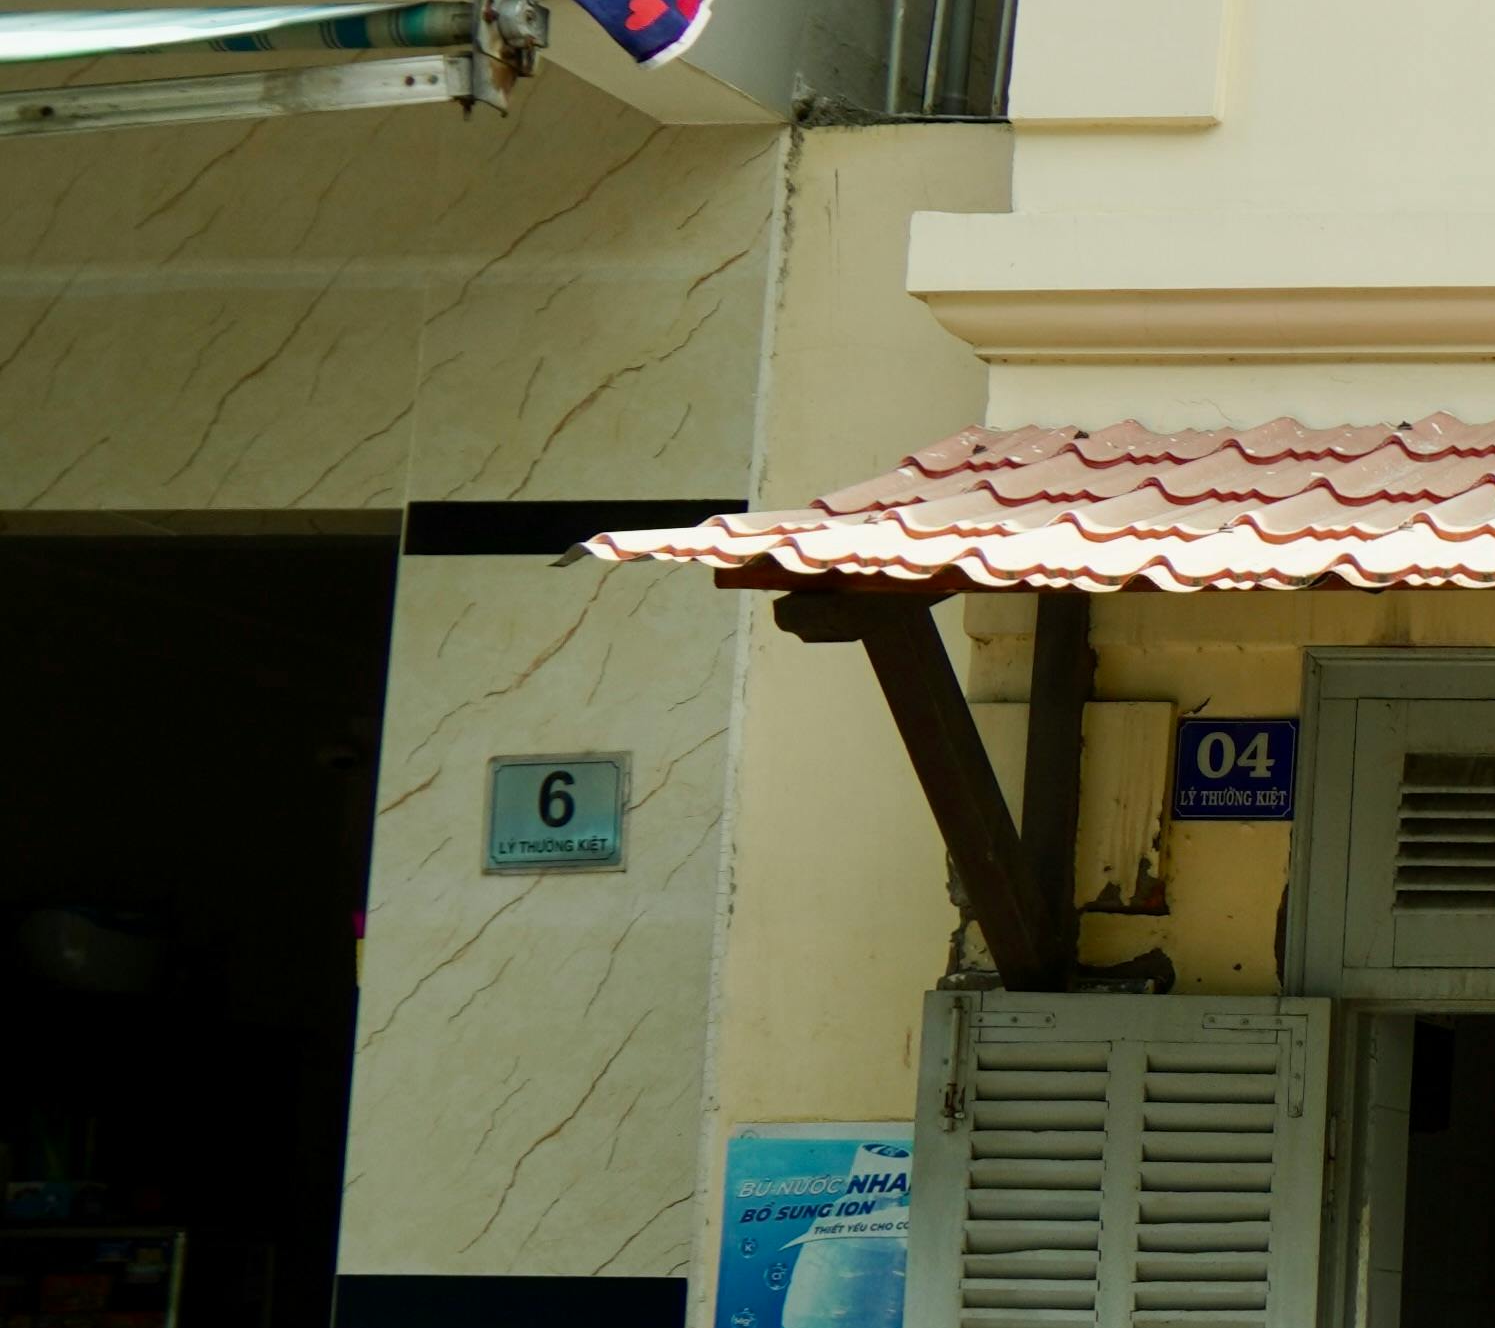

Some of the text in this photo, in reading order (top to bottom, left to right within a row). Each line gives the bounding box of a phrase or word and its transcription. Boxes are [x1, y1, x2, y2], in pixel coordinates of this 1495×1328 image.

[1197, 732, 1276, 779] 04
[539, 770, 575, 828] 6
[1180, 786, 1287, 809] LÝ THƯỜNG KIỆT
[775, 1203, 833, 1221] SUNG
[835, 1201, 876, 1217] ION
[870, 1222, 893, 1232] CHO
